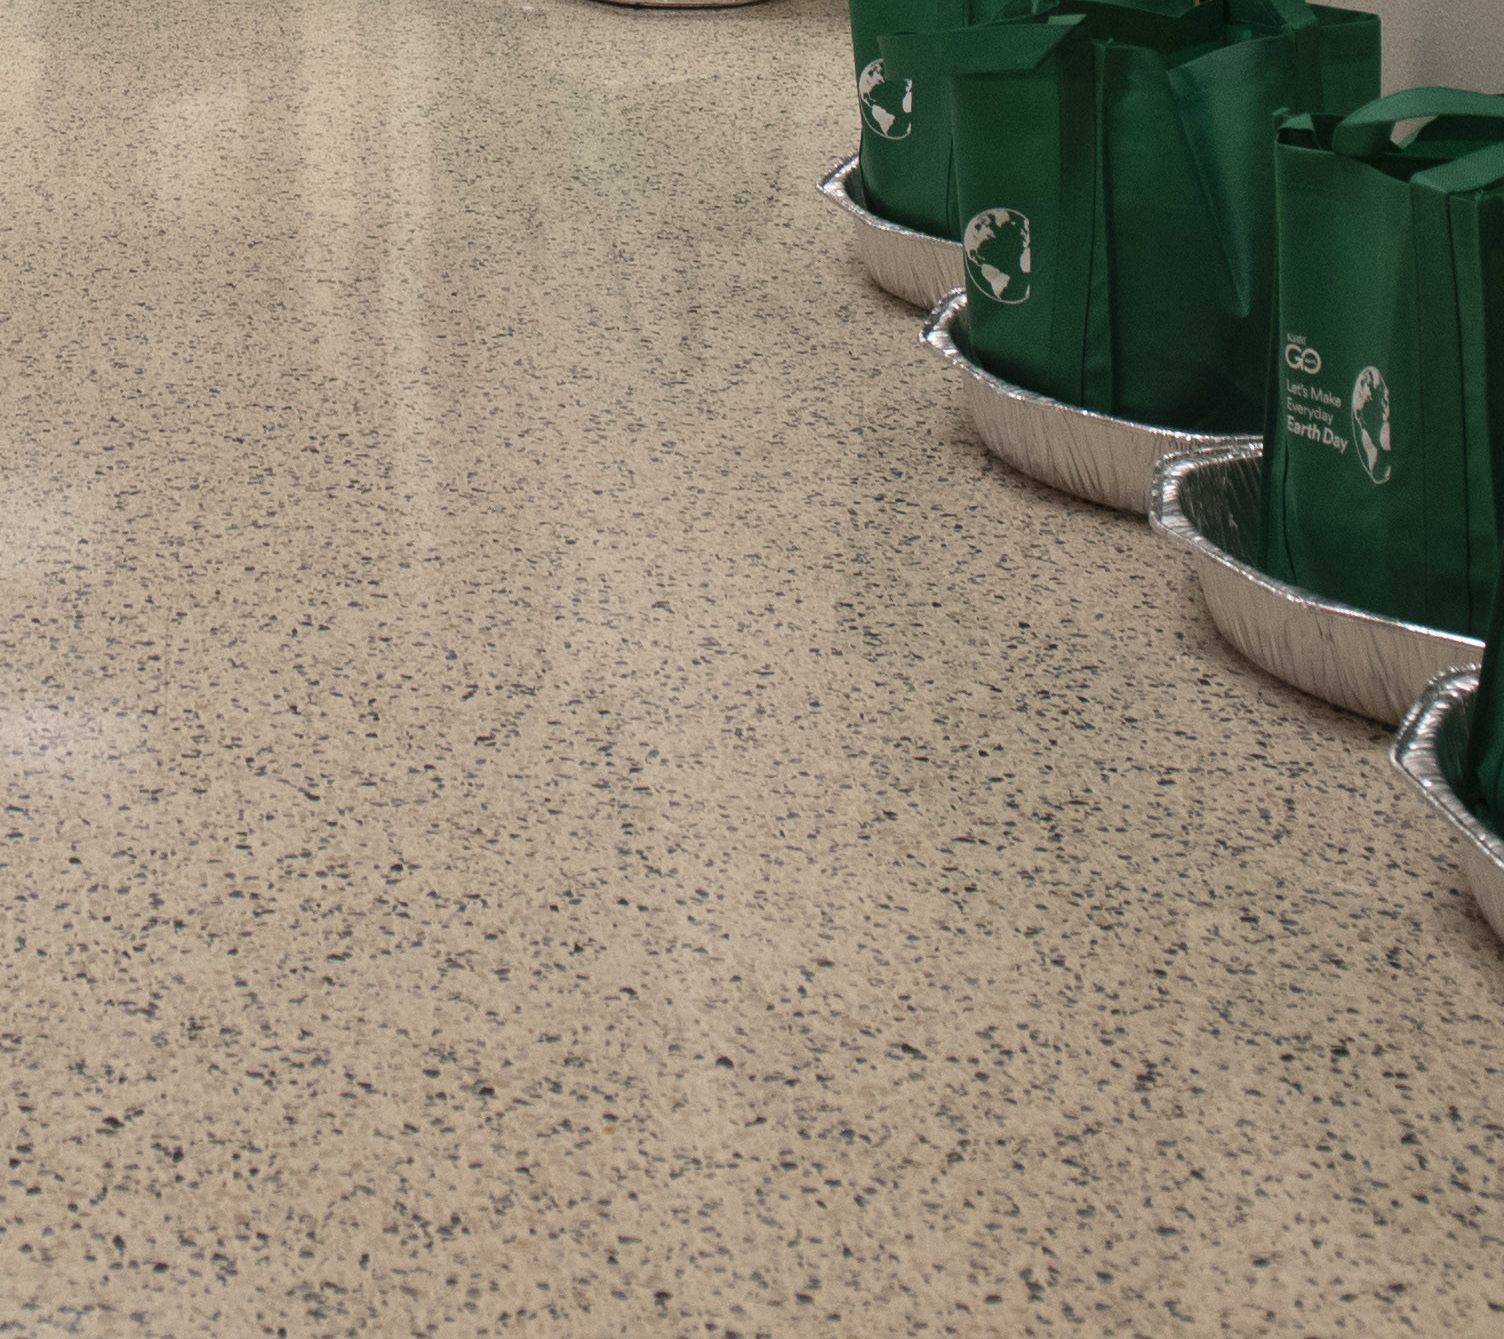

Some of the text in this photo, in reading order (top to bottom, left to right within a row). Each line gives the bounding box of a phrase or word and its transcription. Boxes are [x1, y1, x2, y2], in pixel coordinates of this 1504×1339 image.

[1284, 343, 1322, 375] GO
[1286, 379, 1342, 408] Let's Make
[1286, 396, 1334, 426] Everyday
[1286, 414, 1349, 455] Earth Day
